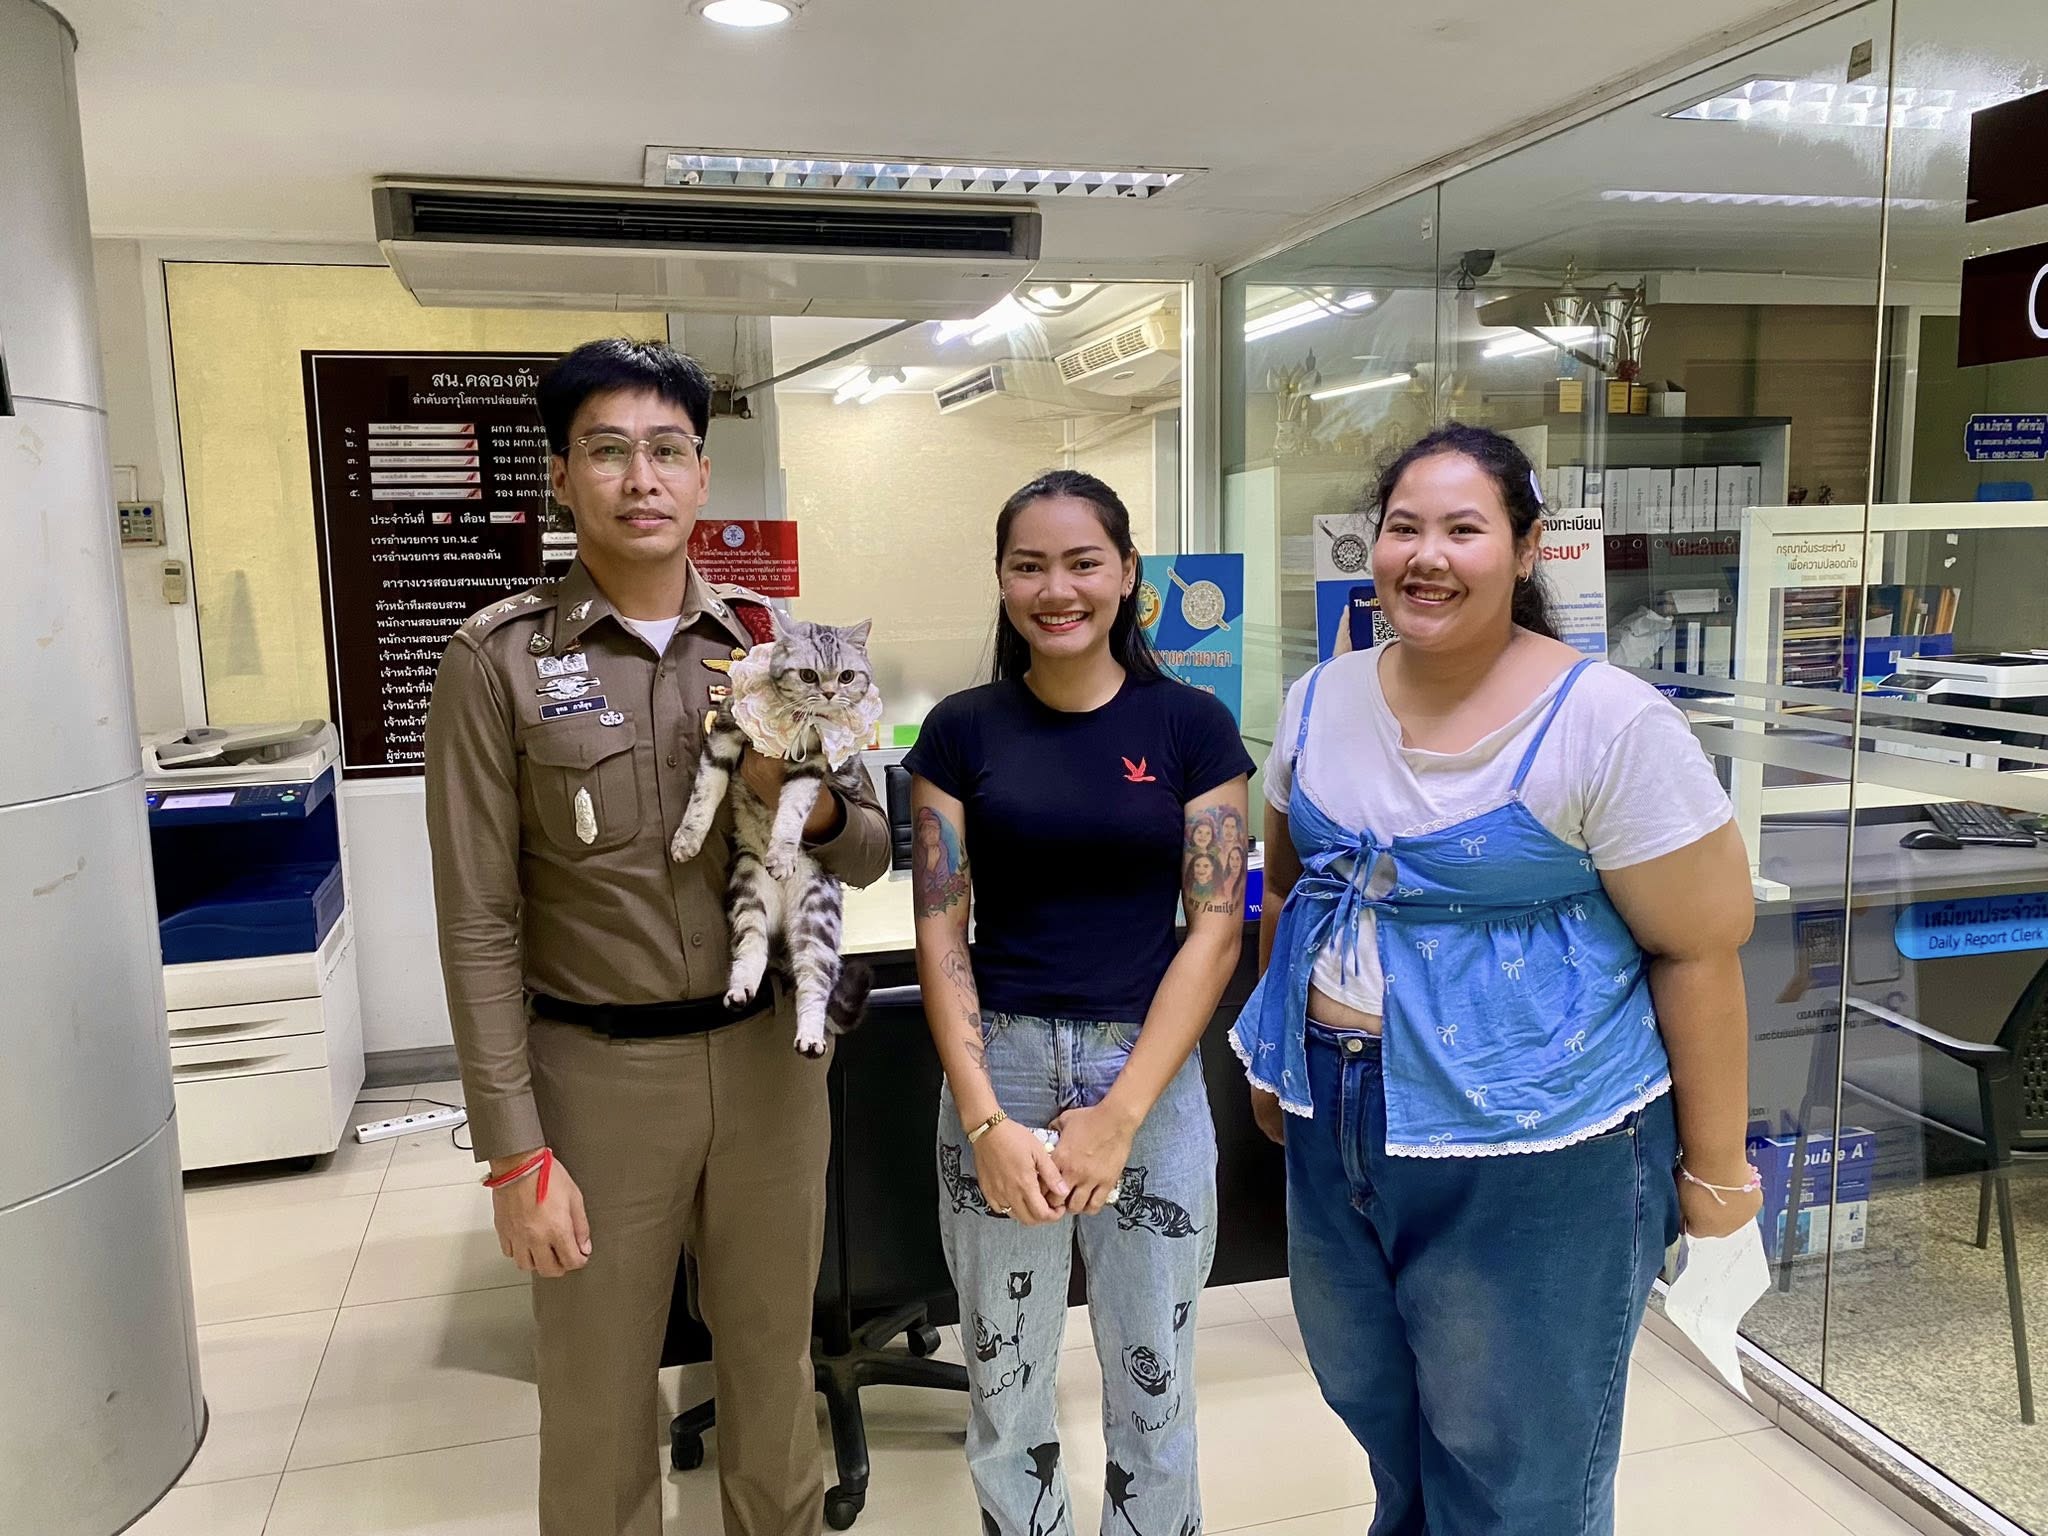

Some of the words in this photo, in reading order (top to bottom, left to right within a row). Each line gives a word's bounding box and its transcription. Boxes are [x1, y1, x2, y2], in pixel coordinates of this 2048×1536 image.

[492, 438, 510, 448] รอง
[493, 455, 511, 465] รอง
[494, 472, 512, 482] รอง
[495, 488, 514, 498] รอง
[370, 510, 425, 525] ประจำวันที่
[459, 512, 486, 524] เดือน
[371, 535, 439, 546] เวรอำนวยการ
[1776, 540, 1846, 556] กรุณาเว้นระยะห่าง
[372, 552, 440, 563] เวรอำนวยการ
[443, 549, 501, 561] สน.คลองตัน
[1787, 555, 1858, 570] เพื่อความปลอดภัย
[375, 599, 466, 611] หัวหน้าทีมสอบสวน
[1202, 901, 1234, 916] family
[1928, 934, 1960, 950] Daily
[1964, 931, 2007, 949] Report
[2011, 928, 2043, 943] Clerk
